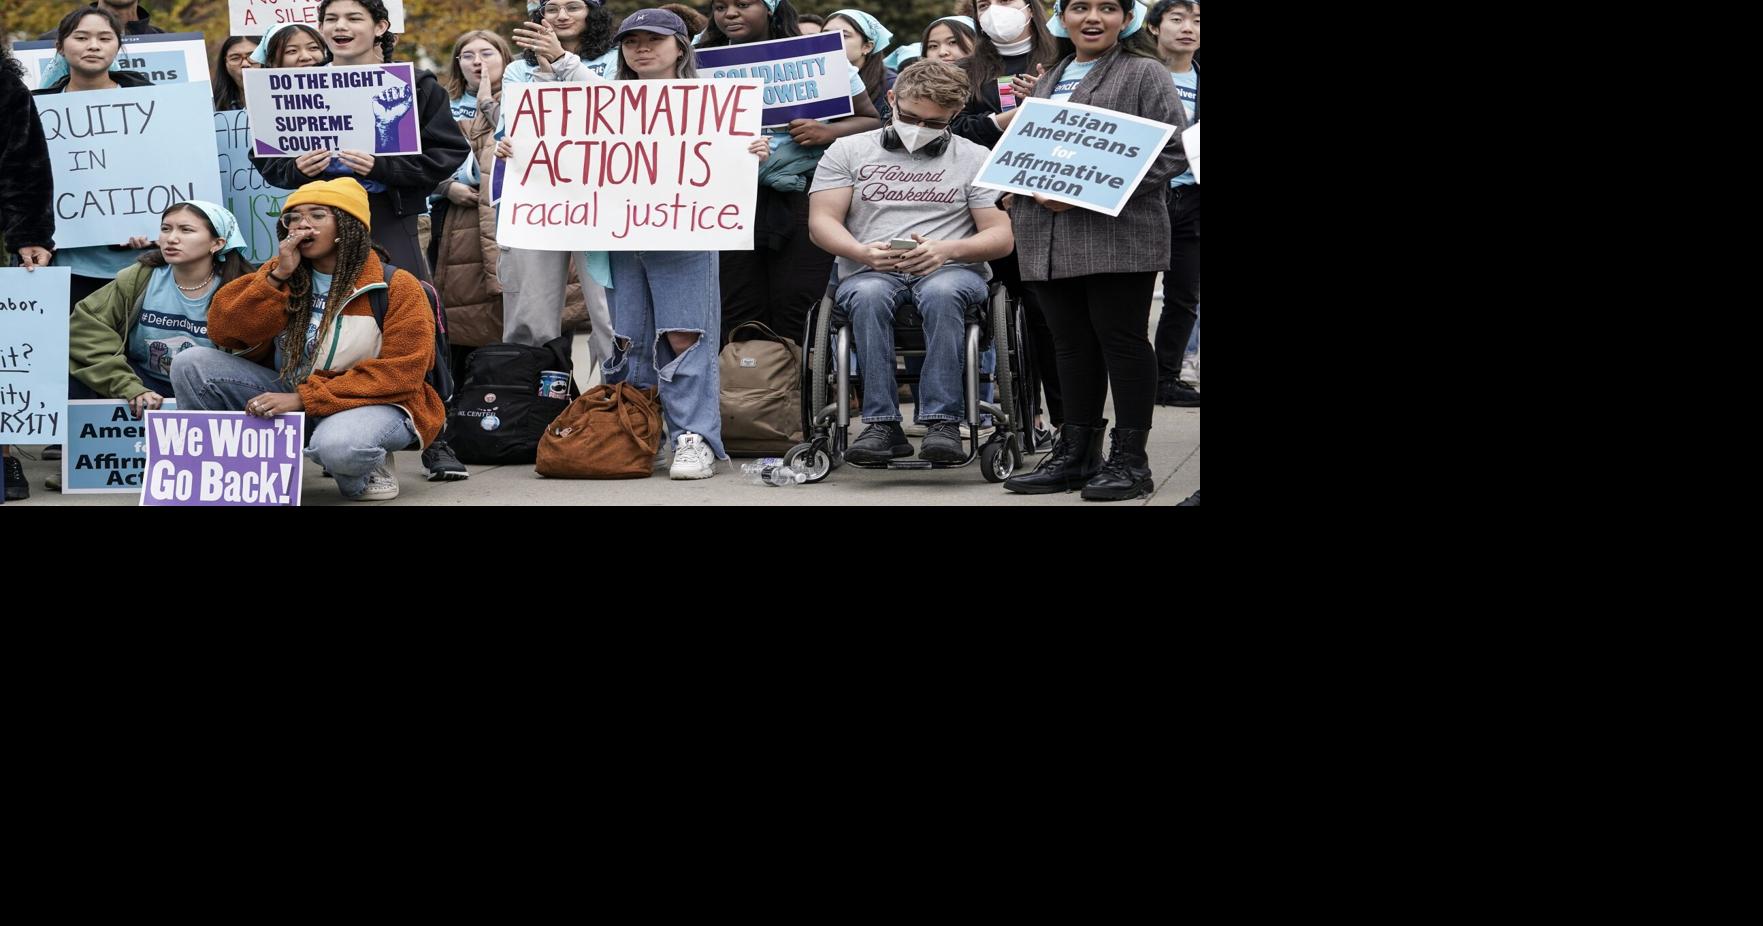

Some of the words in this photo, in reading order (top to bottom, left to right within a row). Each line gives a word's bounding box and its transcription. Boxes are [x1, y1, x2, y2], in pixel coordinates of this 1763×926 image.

[244, 9, 257, 26] A
[274, 6, 320, 24] SILE
[118, 57, 146, 69] an
[269, 74, 291, 90] DO
[294, 73, 329, 89] THE
[332, 71, 385, 87] RIGHT
[763, 80, 819, 105] OWER
[271, 93, 330, 111] THING,
[510, 85, 757, 138] AFFIRMATIVE
[38, 100, 155, 141] QUITY
[275, 115, 354, 132] SUPREME
[1052, 109, 1118, 135] Asian
[279, 136, 339, 152] COURT!
[1017, 121, 1141, 158] Americans
[68, 148, 106, 171] IN
[520, 140, 657, 187] ACTION
[678, 141, 712, 187] IS
[1050, 145, 1077, 160] for
[858, 164, 946, 183] Harvard
[996, 150, 1125, 190] Affirmative
[861, 183, 958, 204] Basketball
[1009, 170, 1083, 197] Action
[56, 182, 194, 220] CATION
[512, 191, 597, 227] racial
[612, 193, 743, 238] justice.
[80, 423, 145, 438] Amer
[153, 418, 203, 456] We
[208, 418, 297, 458] Won't
[106, 470, 145, 485] Act
[150, 459, 193, 500] Go
[201, 461, 293, 503] Back!
